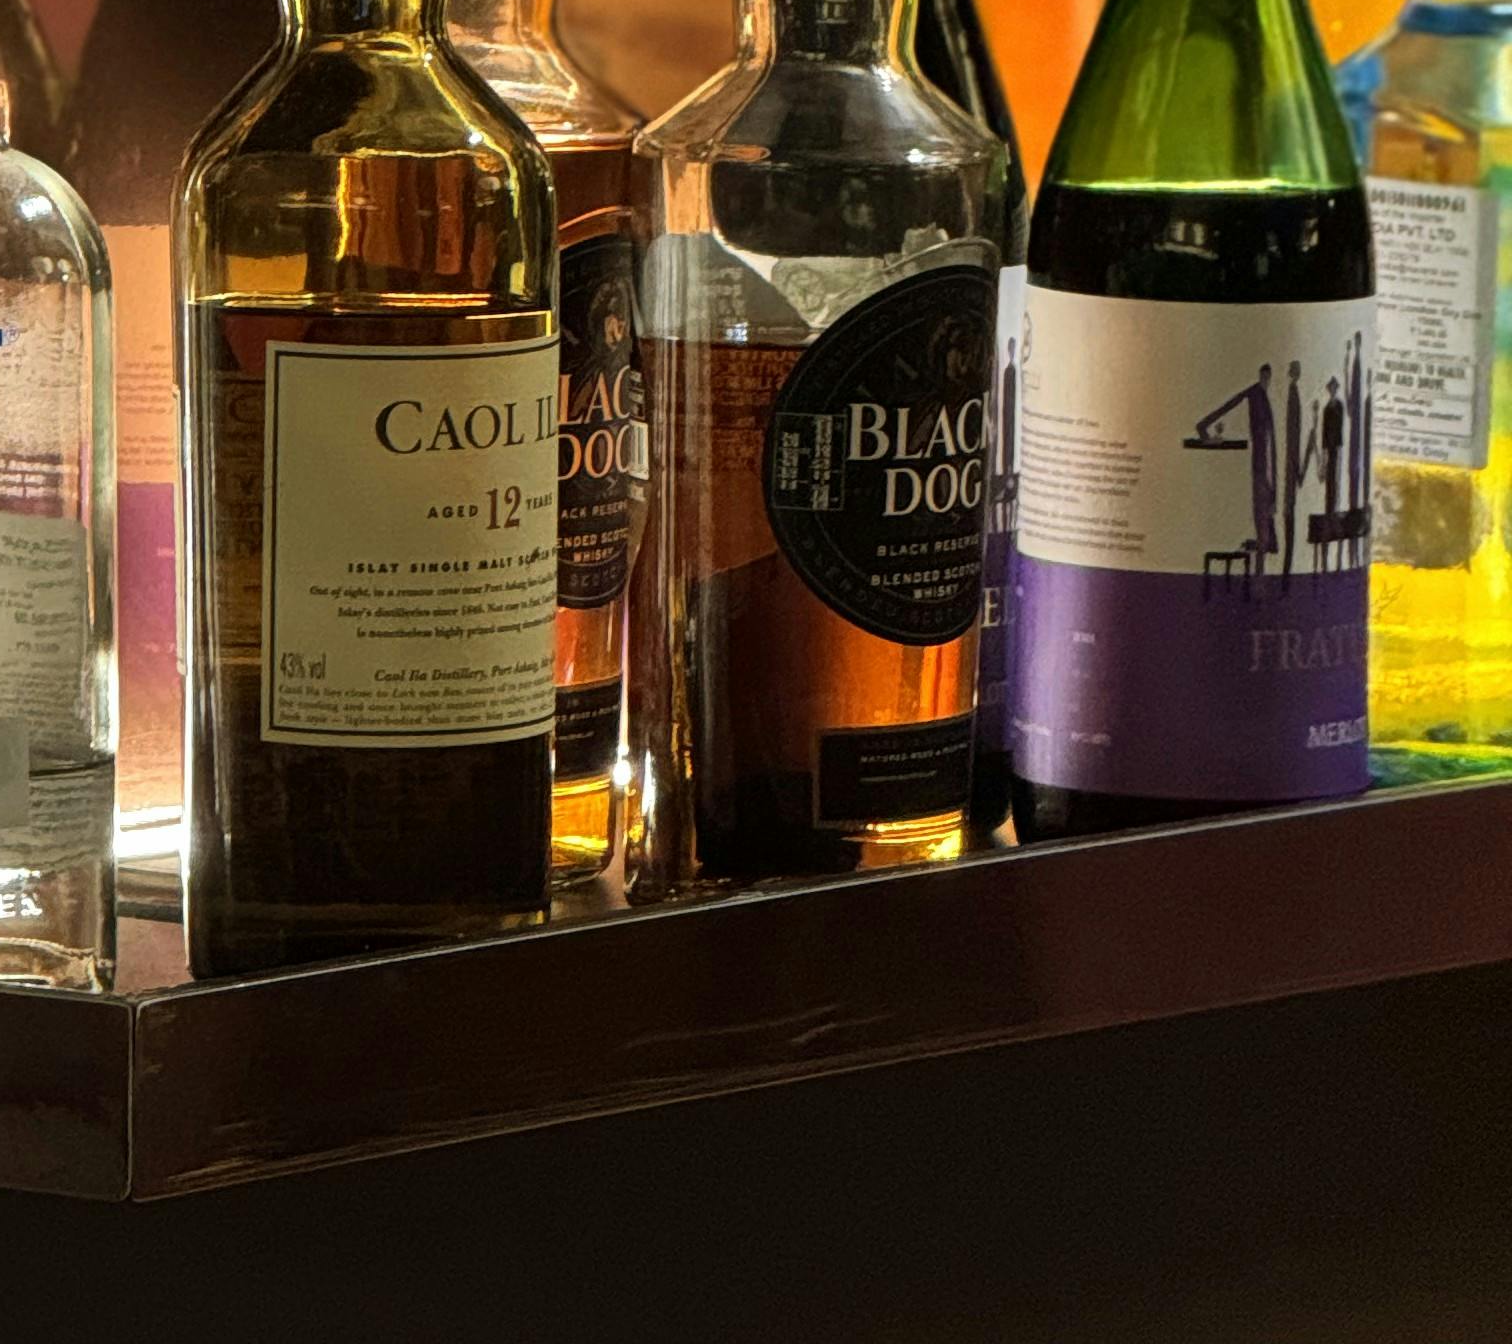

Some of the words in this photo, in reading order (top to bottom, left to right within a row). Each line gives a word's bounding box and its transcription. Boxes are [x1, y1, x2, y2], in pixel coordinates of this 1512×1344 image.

[1428, 226, 1456, 243] LTD
[375, 399, 525, 455] CAOL
[881, 457, 982, 518] DOG
[426, 504, 479, 519] AGED
[485, 484, 522, 531] 12
[876, 542, 929, 558] BLACK
[348, 561, 400, 575] ISLAY
[409, 560, 471, 575] SINGLE
[476, 555, 513, 571] MALT
[869, 572, 940, 587] BLENDED
[912, 583, 959, 601] WHISKY
[337, 606, 374, 620] Islay's
[375, 606, 431, 619] distilleries
[434, 624, 465, 641] highly
[308, 651, 327, 681] vol
[408, 669, 428, 682] Ila
[430, 665, 489, 682] Distillery,
